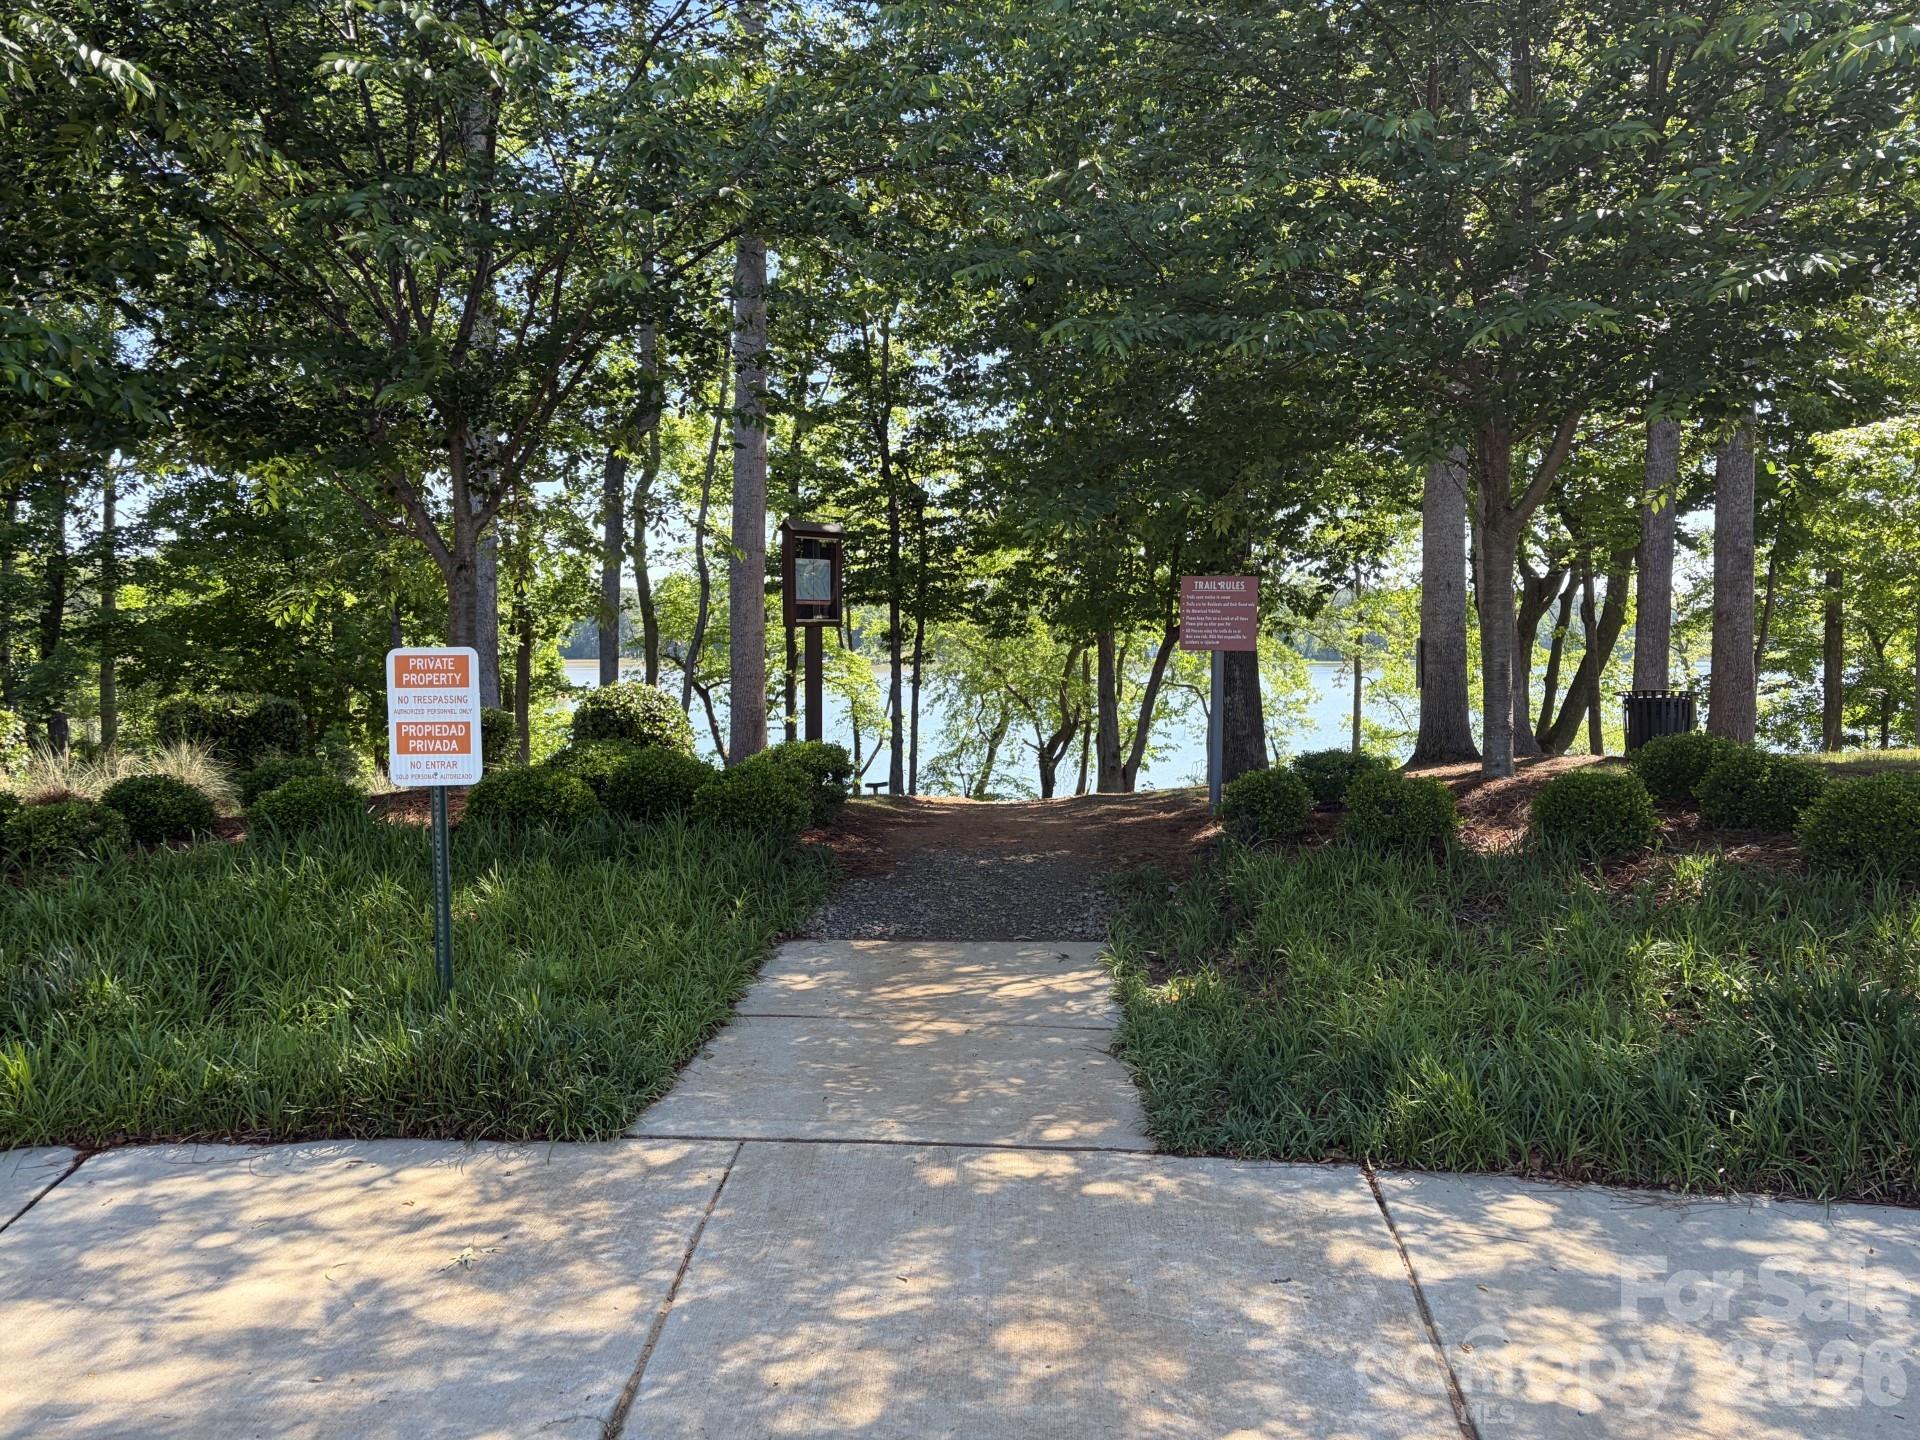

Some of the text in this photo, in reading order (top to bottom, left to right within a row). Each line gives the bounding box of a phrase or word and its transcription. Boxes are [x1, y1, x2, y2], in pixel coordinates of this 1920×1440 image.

[1194, 581, 1245, 590] TRAIL RULES
[409, 657, 456, 670] PRIVATE
[402, 673, 462, 685] PROPERTY
[397, 695, 468, 704] NO TRESPASSING
[401, 724, 466, 737] PROPIEDAD
[409, 739, 459, 751] PRIVADA
[410, 761, 458, 769] NO ENTRAR
